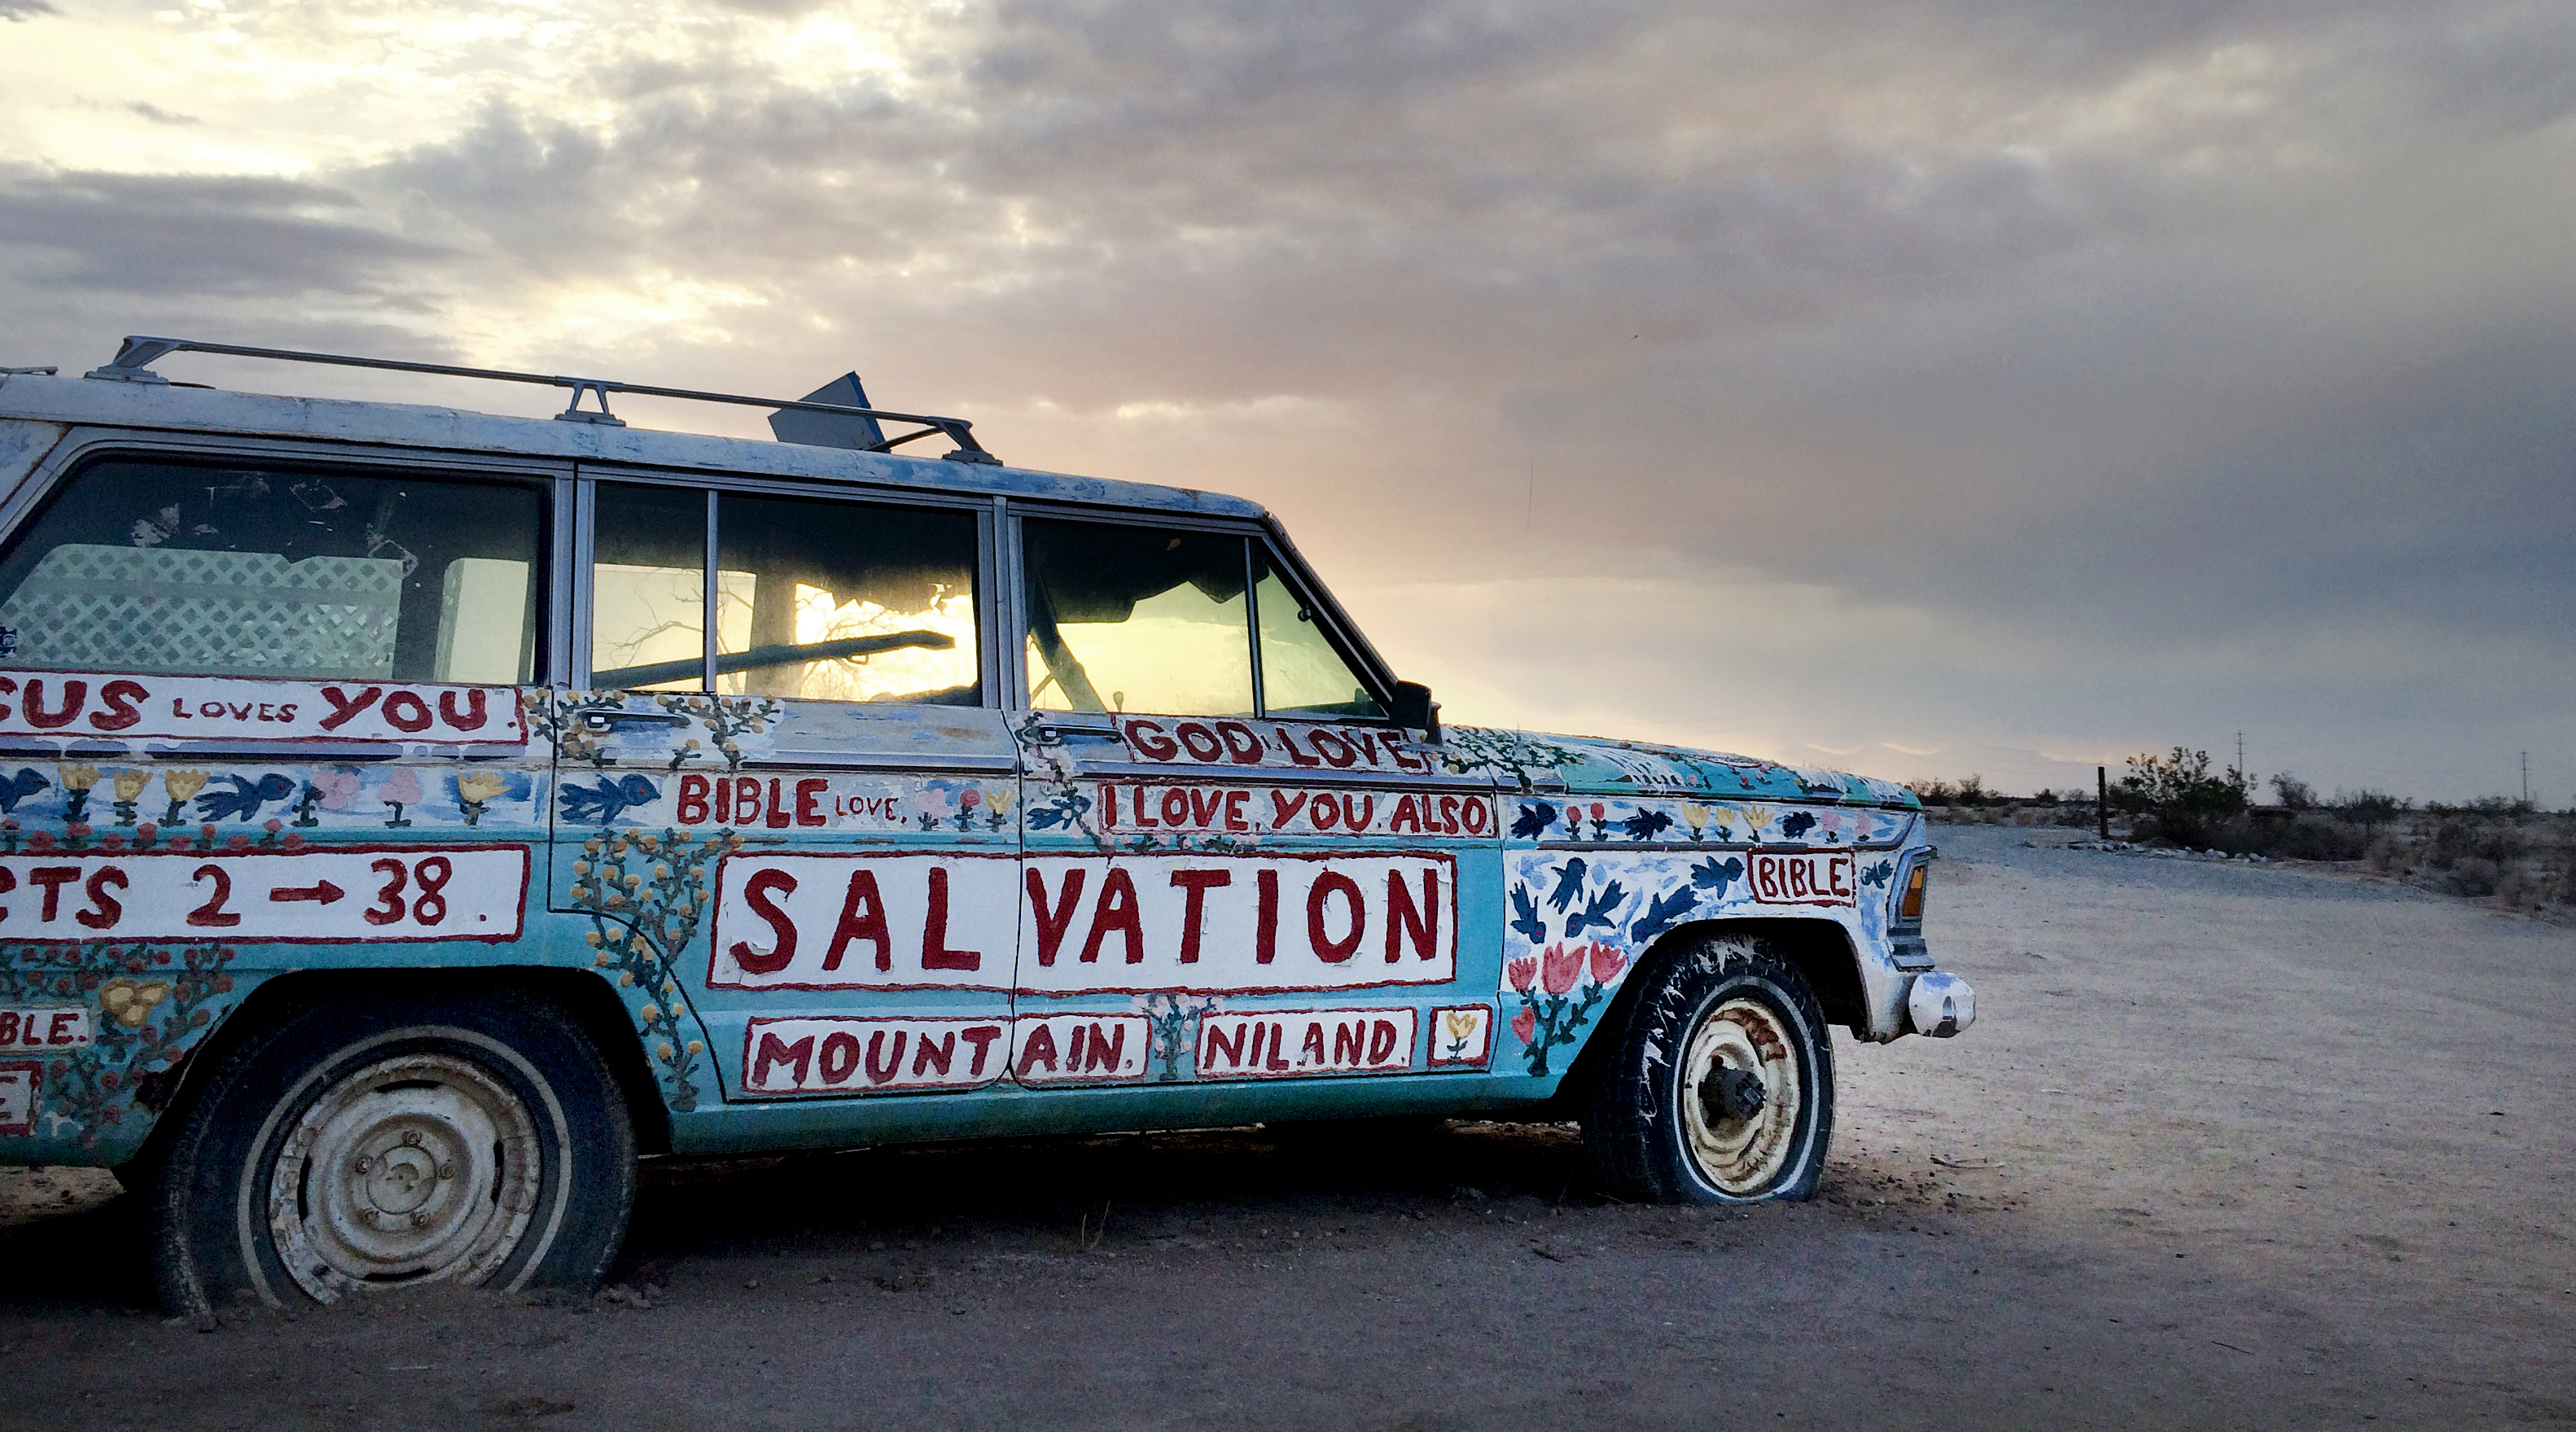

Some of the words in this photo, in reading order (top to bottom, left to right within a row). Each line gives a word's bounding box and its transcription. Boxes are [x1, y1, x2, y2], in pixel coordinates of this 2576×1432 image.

[172, 698, 298, 723] LOVES
[677, 774, 829, 828] BIBLE
[1105, 786, 1117, 829] I
[186, 865, 240, 926] 2
[1759, 856, 1851, 898] BIBLE
[729, 865, 1439, 974] SALVATION
